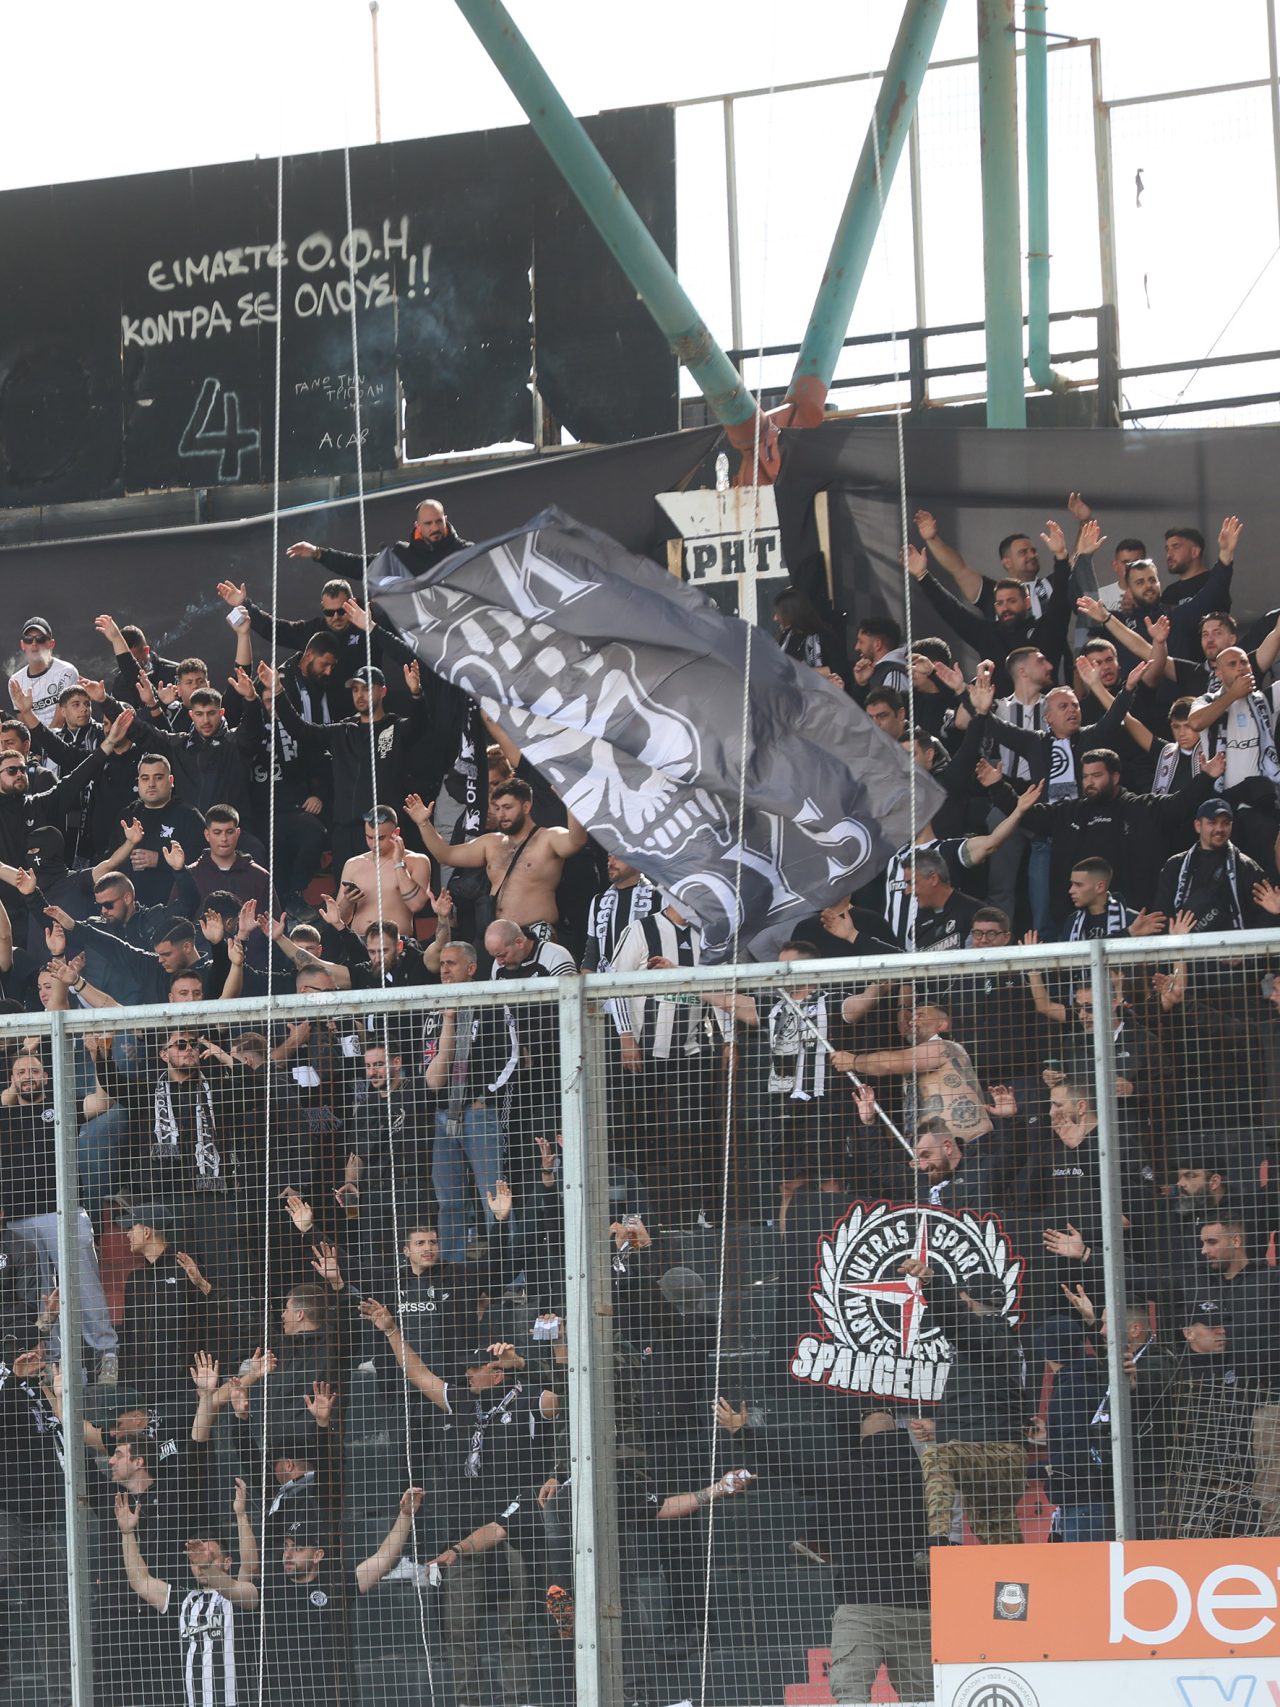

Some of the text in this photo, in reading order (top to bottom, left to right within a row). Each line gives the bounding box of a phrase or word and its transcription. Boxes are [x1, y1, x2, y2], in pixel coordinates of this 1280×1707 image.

[121, 301, 232, 347] ΚΟΝΤΡΑ
[237, 292, 278, 327] ΣΕ
[178, 377, 260, 481] 4
[682, 534, 788, 581] ΡΗΤ
[847, 1220, 910, 1280] ULTRAS
[932, 1223, 985, 1281] SPART
[1109, 1542, 1280, 1645] be
